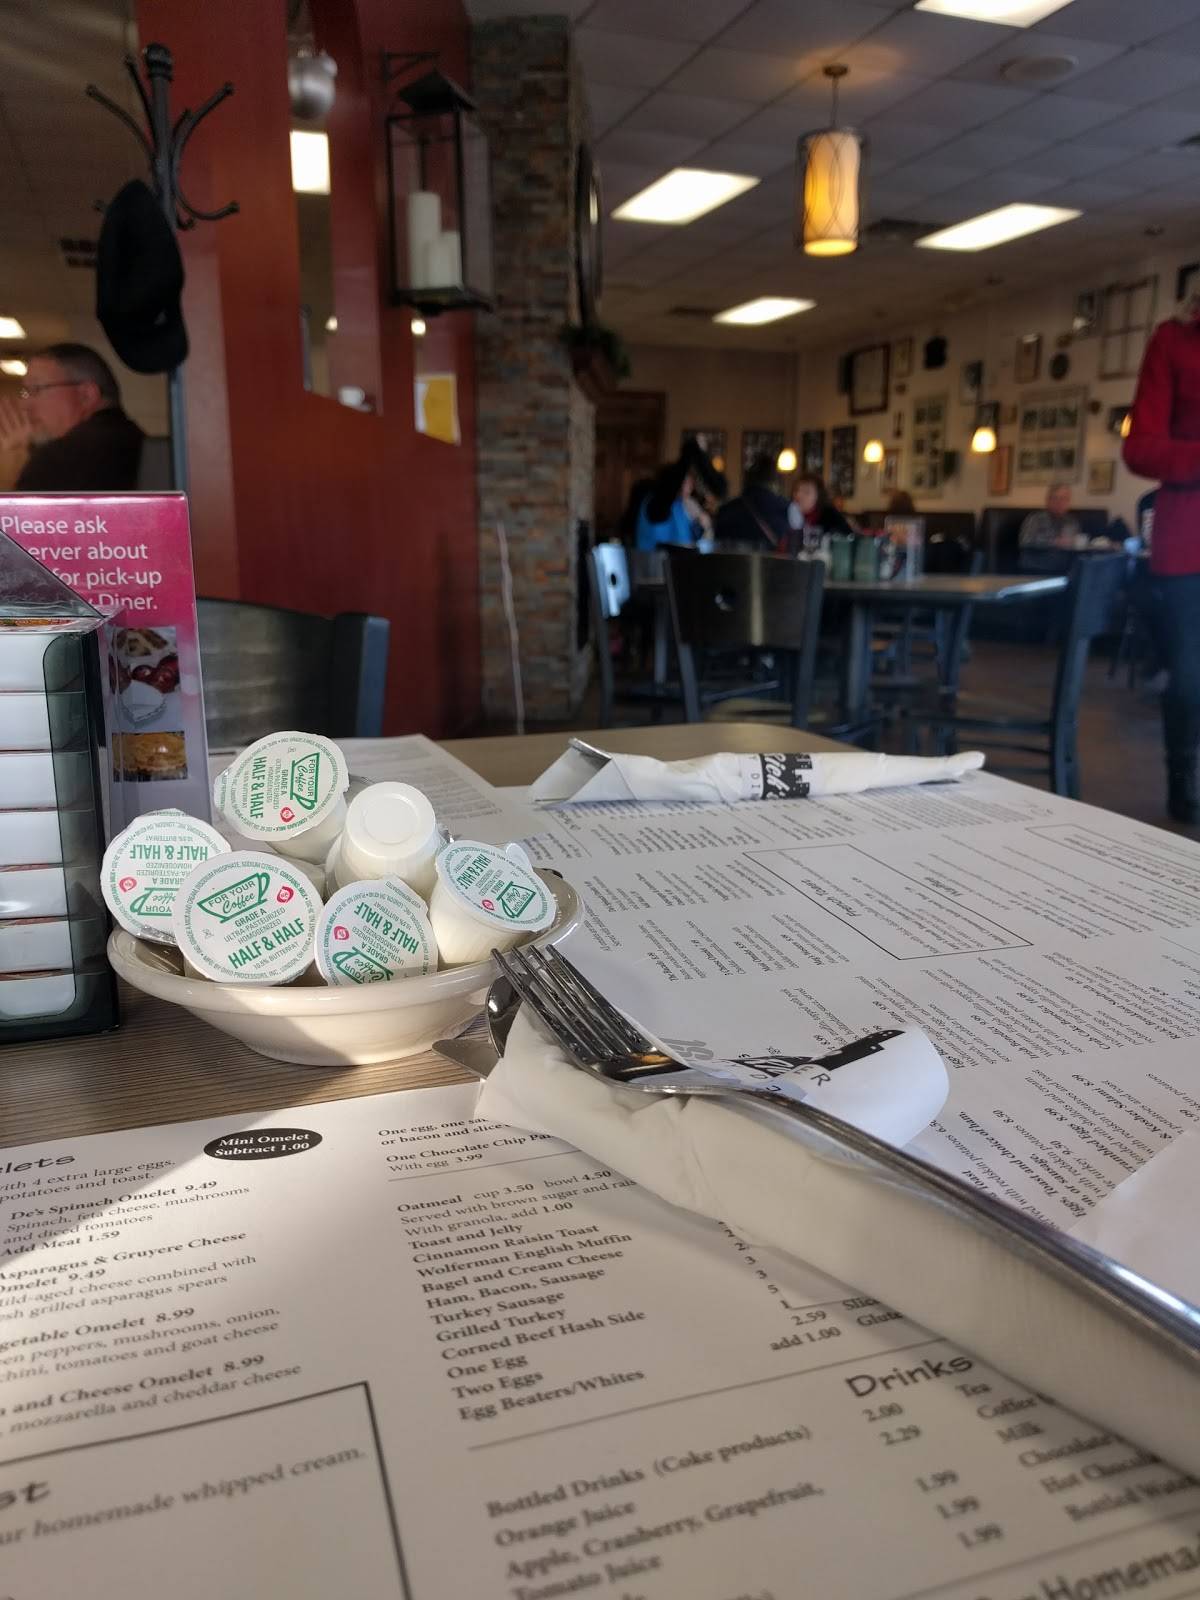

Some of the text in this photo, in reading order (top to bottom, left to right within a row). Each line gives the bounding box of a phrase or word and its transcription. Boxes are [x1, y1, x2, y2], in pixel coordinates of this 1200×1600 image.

[1, 516, 108, 534] Please ask
[28, 542, 148, 561] erver about
[86, 569, 162, 590] pick-up
[250, 756, 267, 819] HALF & HALF
[281, 769, 289, 789] GRADE
[297, 765, 308, 792] Coffee
[307, 775, 315, 797] YOUR
[130, 844, 208, 861] HALF & HALF
[472, 854, 492, 872] HALF
[456, 871, 476, 889] HALF
[208, 880, 256, 908] FOR YOUR
[222, 892, 255, 914] Coffee
[234, 908, 267, 928] GRADE A
[238, 919, 282, 944] HOMOGENIZED
[353, 902, 420, 954] HALF & HALF
[228, 918, 305, 969] HALF & HALF
[269, 941, 299, 962] BUTTERFAT
[366, 946, 389, 964] GRADE
[214, 1142, 310, 1157] Subtract 1.00
[220, 1133, 310, 1147] Mini Omelet
[386, 1135, 527, 1163] One Chocolate Chip
[986, 1136, 1015, 1159] choice
[1015, 1124, 1053, 1151] potatoes
[389, 1153, 483, 1172] With egg 3.99
[1009, 1159, 1034, 1176] and
[1087, 1140, 1137, 1174] crambled
[47, 1172, 88, 1184] extra
[94, 1165, 133, 1177] large
[1030, 1175, 1059, 1197] Toast
[0, 1186, 70, 1204] potatoes
[76, 1178, 106, 1190] and
[10, 1180, 217, 1220] De's Spinach Omelet 9.49
[398, 1169, 612, 1212] Oatmeal cup 3.50 bowl 4.50
[7, 1187, 250, 1233] Spinach, feta cheese, mushrooms
[404, 1201, 574, 1236] With granola, add 1.00
[3, 1214, 153, 1245] and diced tomatoes
[408, 1223, 523, 1250] Toast and Jelly
[1, 1230, 120, 1257] Add Meat 1.59
[94, 1256, 108, 1265] &
[113, 1243, 184, 1261] Gruyere
[188, 1232, 247, 1249] Cheese
[412, 1224, 600, 1263] Cinnamon Raisin Toast
[416, 1234, 632, 1278] Wolferman English Muffin
[422, 1250, 624, 1293] Bagel and Cream Cheese
[426, 1269, 606, 1309] Ham, Bacon, Sausage
[430, 1291, 566, 1325] Turkey Sausage
[790, 1310, 827, 1326] 2.59
[0, 1307, 195, 1353] getable Omelet 8.99
[436, 1309, 567, 1342] Grilled Turkey
[441, 1309, 646, 1360] Corned Beef Hash Side
[769, 1326, 842, 1351] add 1.00
[447, 1354, 529, 1380] One Egg
[845, 1355, 974, 1399] Drinks
[13, 1354, 265, 1413] and Cheese Omelet 8.99
[452, 1371, 544, 1399] Two Eggs
[458, 1369, 645, 1421] Egg Beaters/Whites
[486, 1485, 568, 1519] Bottled
[571, 1469, 645, 1496] Drinks
[718, 1424, 812, 1463] products)
[33, 1494, 175, 1538] homemade
[181, 1464, 284, 1505] whipped
[494, 1501, 636, 1548] Orange Juice
